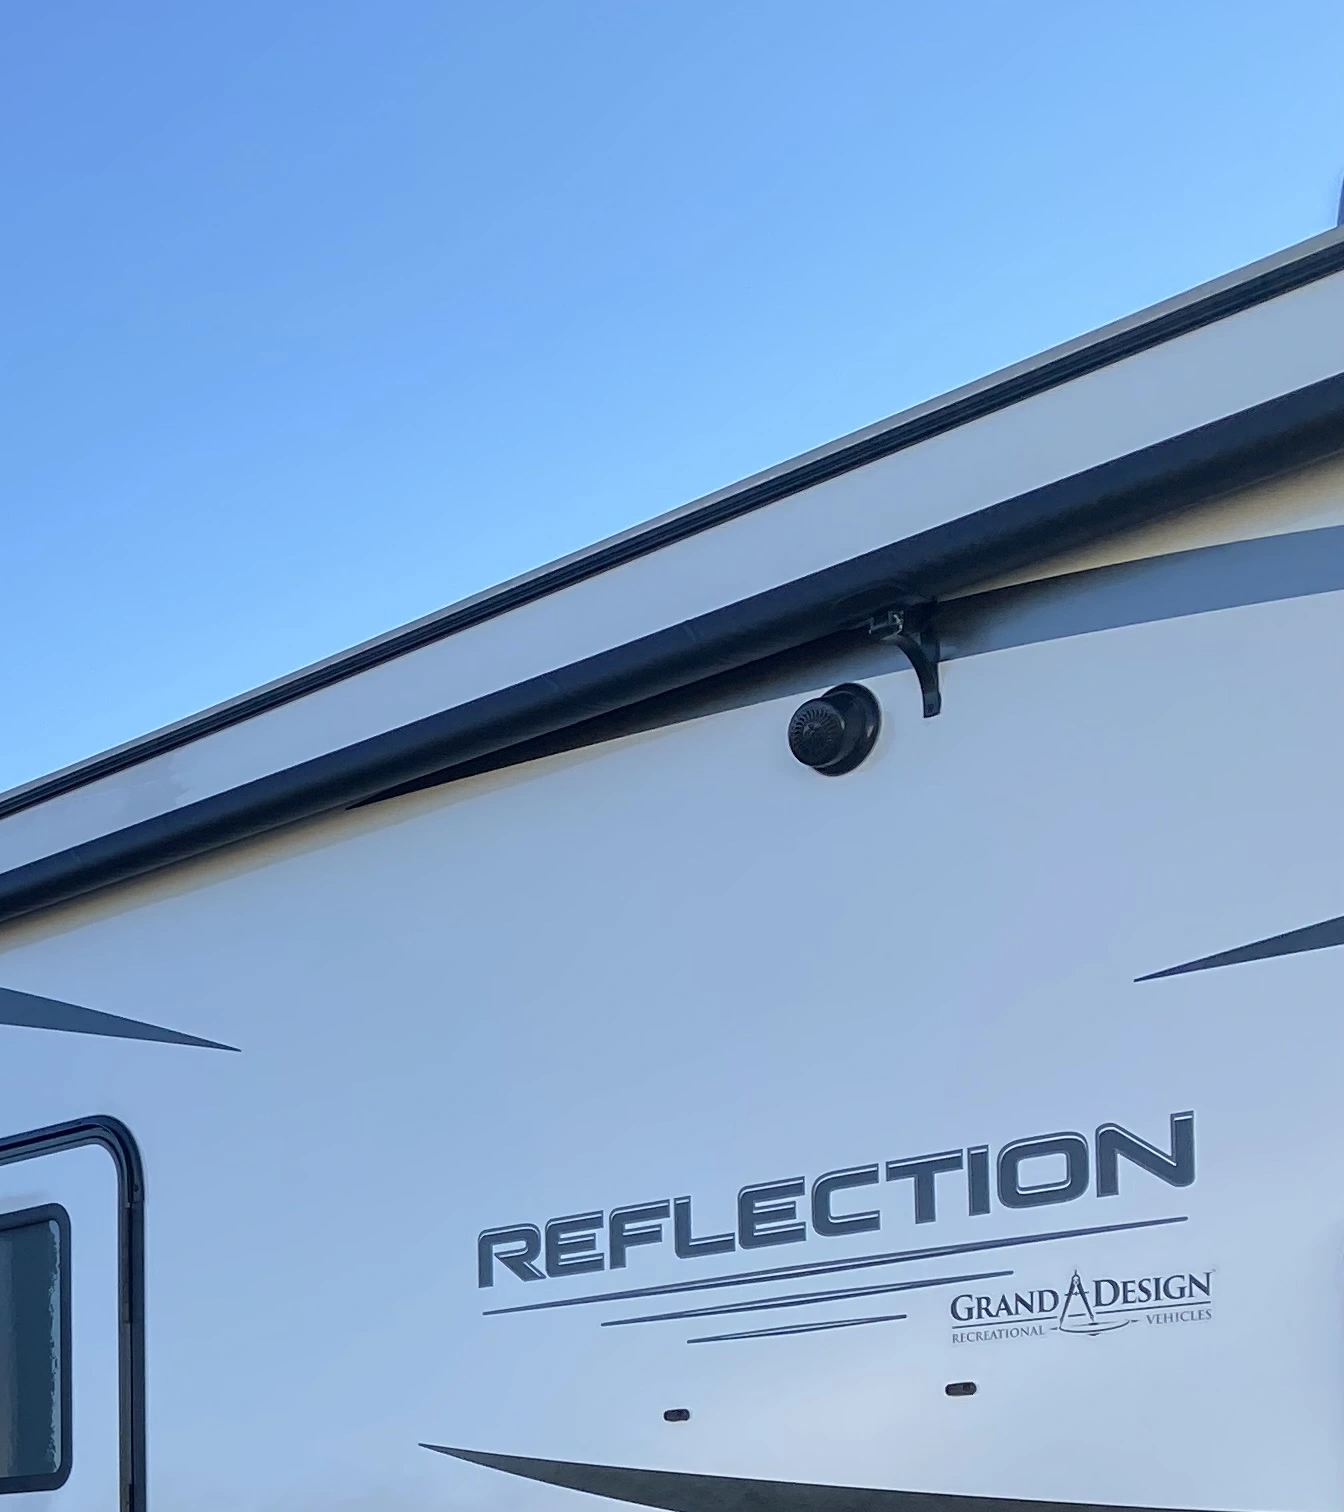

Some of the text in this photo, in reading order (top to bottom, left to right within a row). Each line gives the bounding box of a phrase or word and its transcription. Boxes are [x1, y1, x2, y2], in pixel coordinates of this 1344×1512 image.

[477, 1110, 1196, 1288] REFLECTION
[950, 1272, 1212, 1322] GRAND DESIGN
[952, 1309, 1212, 1345] RECREATIONAL VEHICLES
